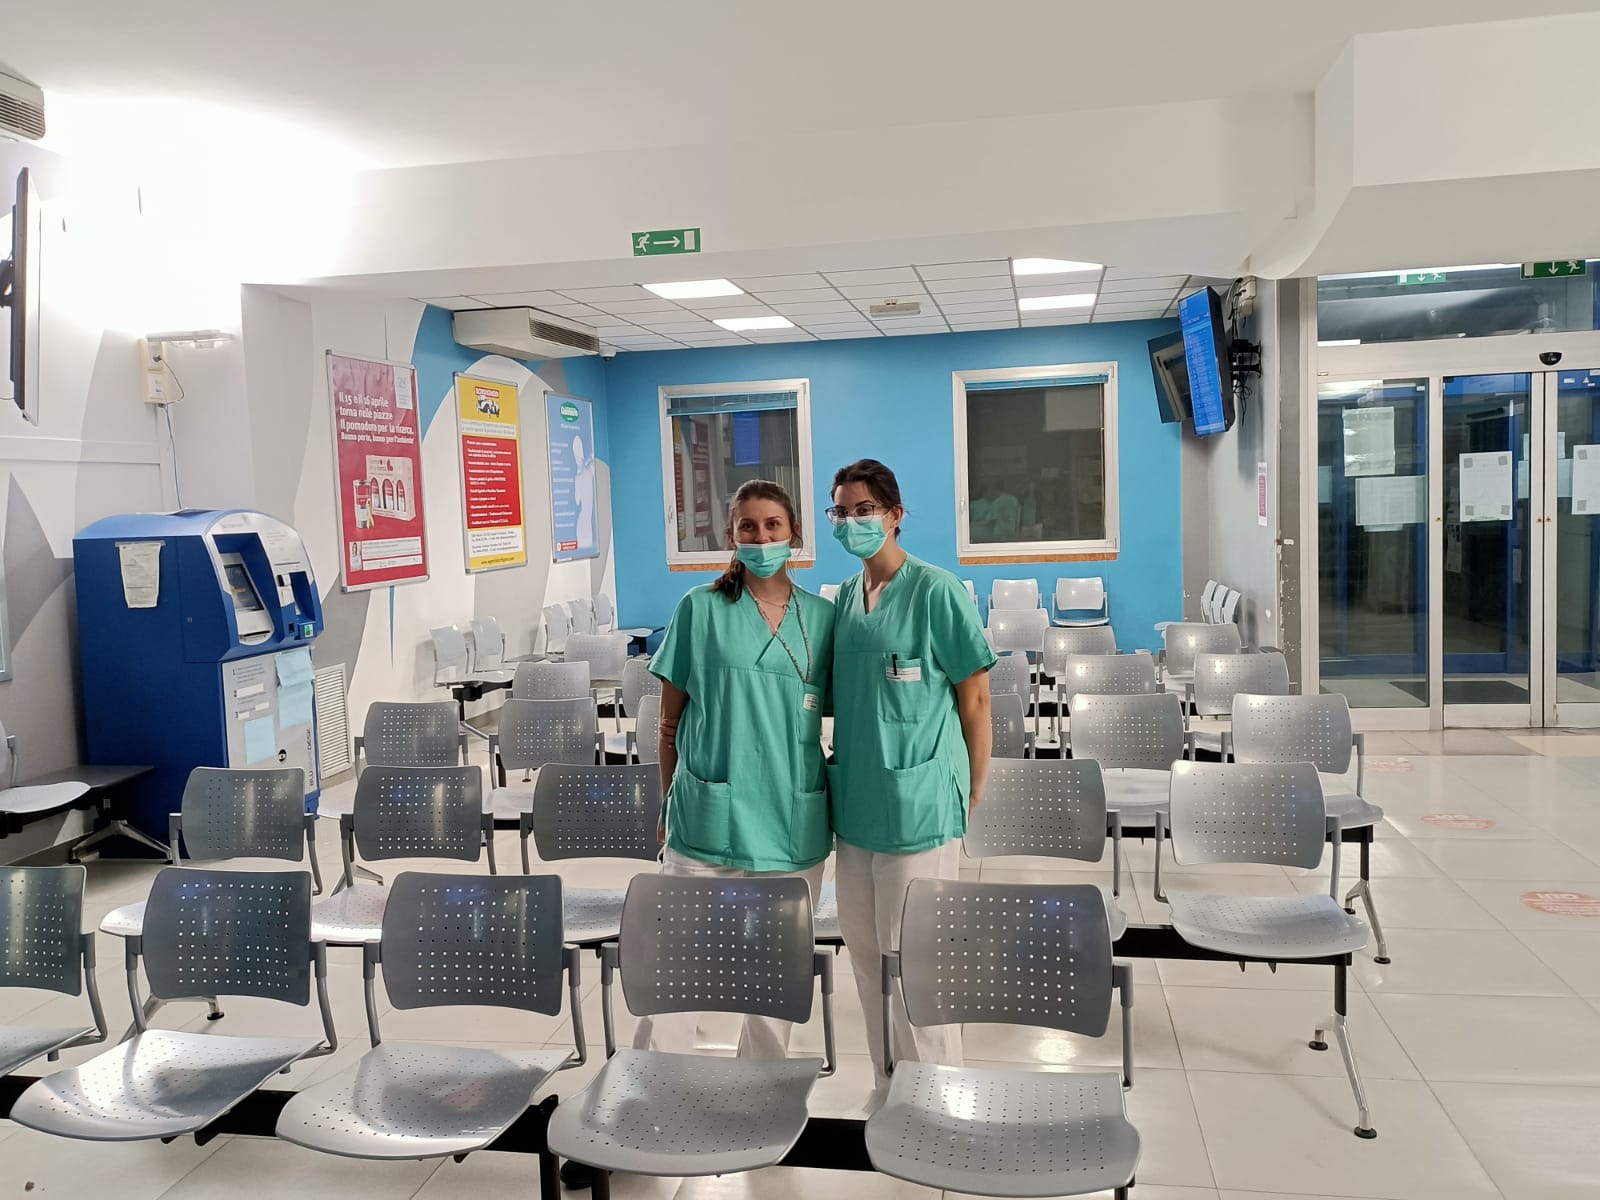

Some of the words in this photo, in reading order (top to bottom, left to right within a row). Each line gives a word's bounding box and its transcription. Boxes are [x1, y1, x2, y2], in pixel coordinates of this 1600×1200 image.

[345, 394, 352, 405] 15
[371, 397, 388, 408] aprile
[340, 406, 357, 417] torna
[373, 409, 393, 421] piazze
[346, 420, 377, 432] pomodoro
[377, 423, 388, 434] per
[389, 422, 395, 433] la
